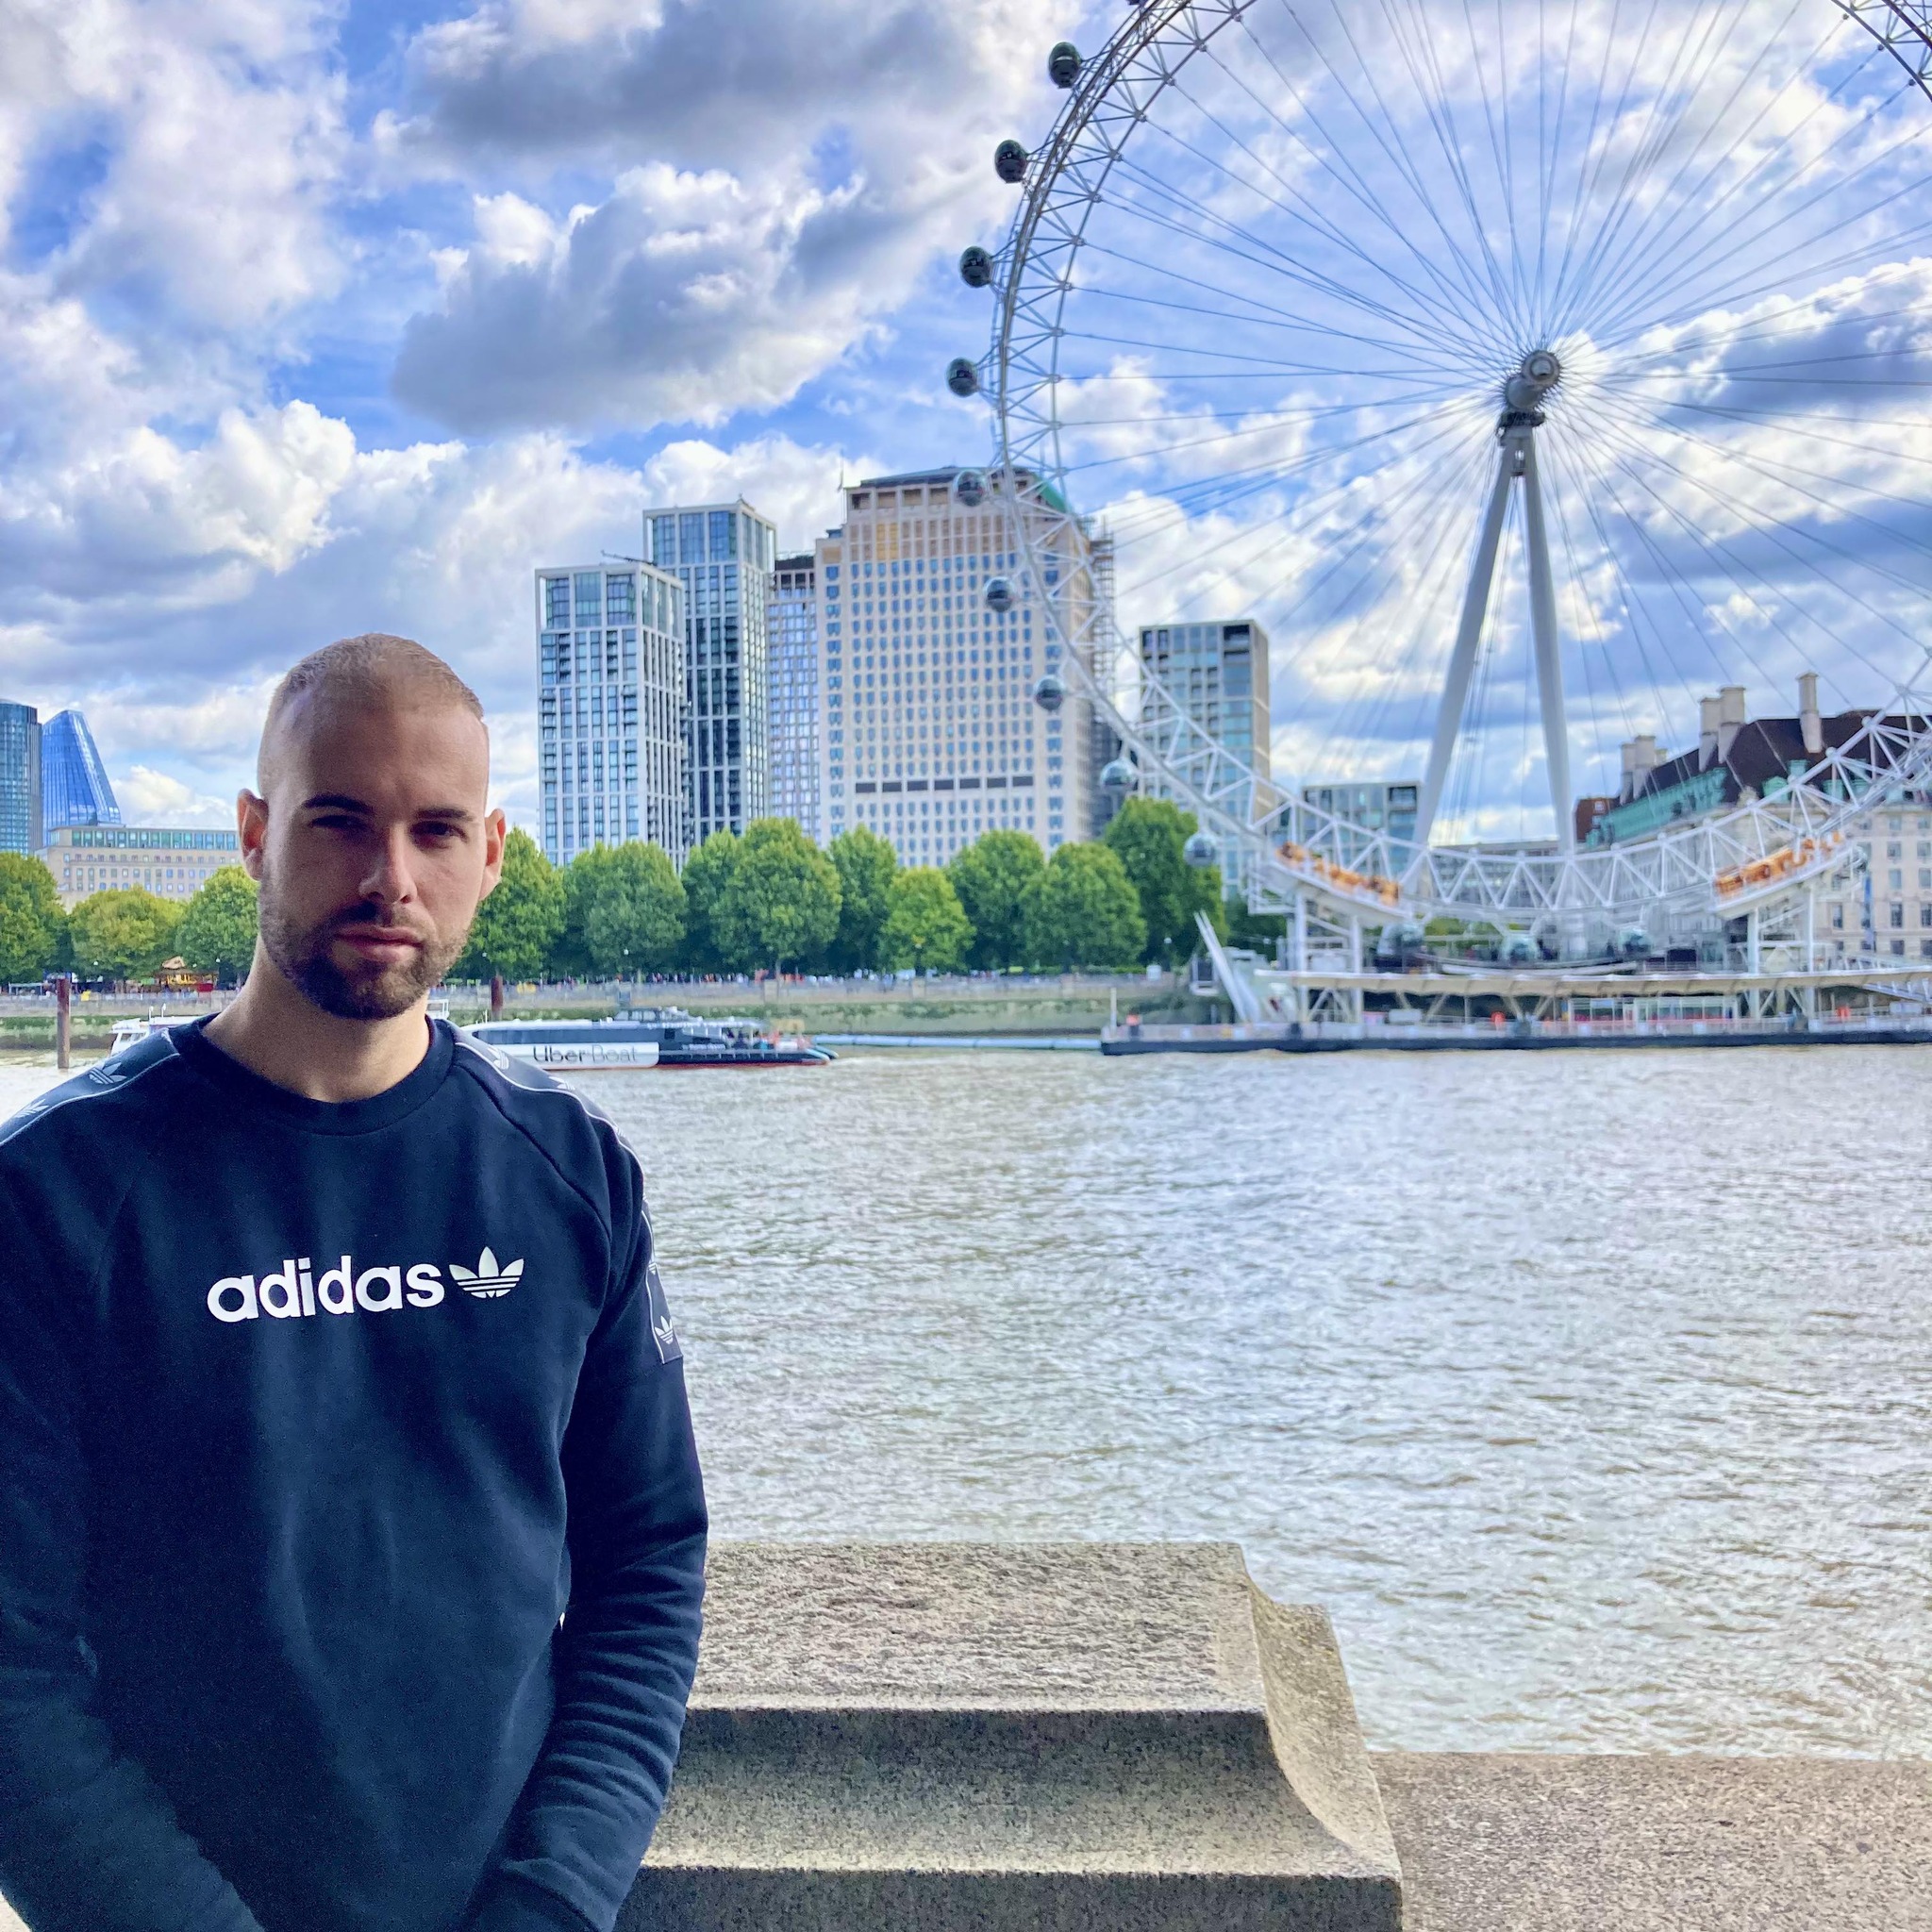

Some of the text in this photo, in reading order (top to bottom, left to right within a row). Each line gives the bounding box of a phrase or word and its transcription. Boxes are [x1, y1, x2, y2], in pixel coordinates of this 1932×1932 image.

[533, 1043, 638, 1062] Uber Boat
[207, 1255, 445, 1323] adidas
